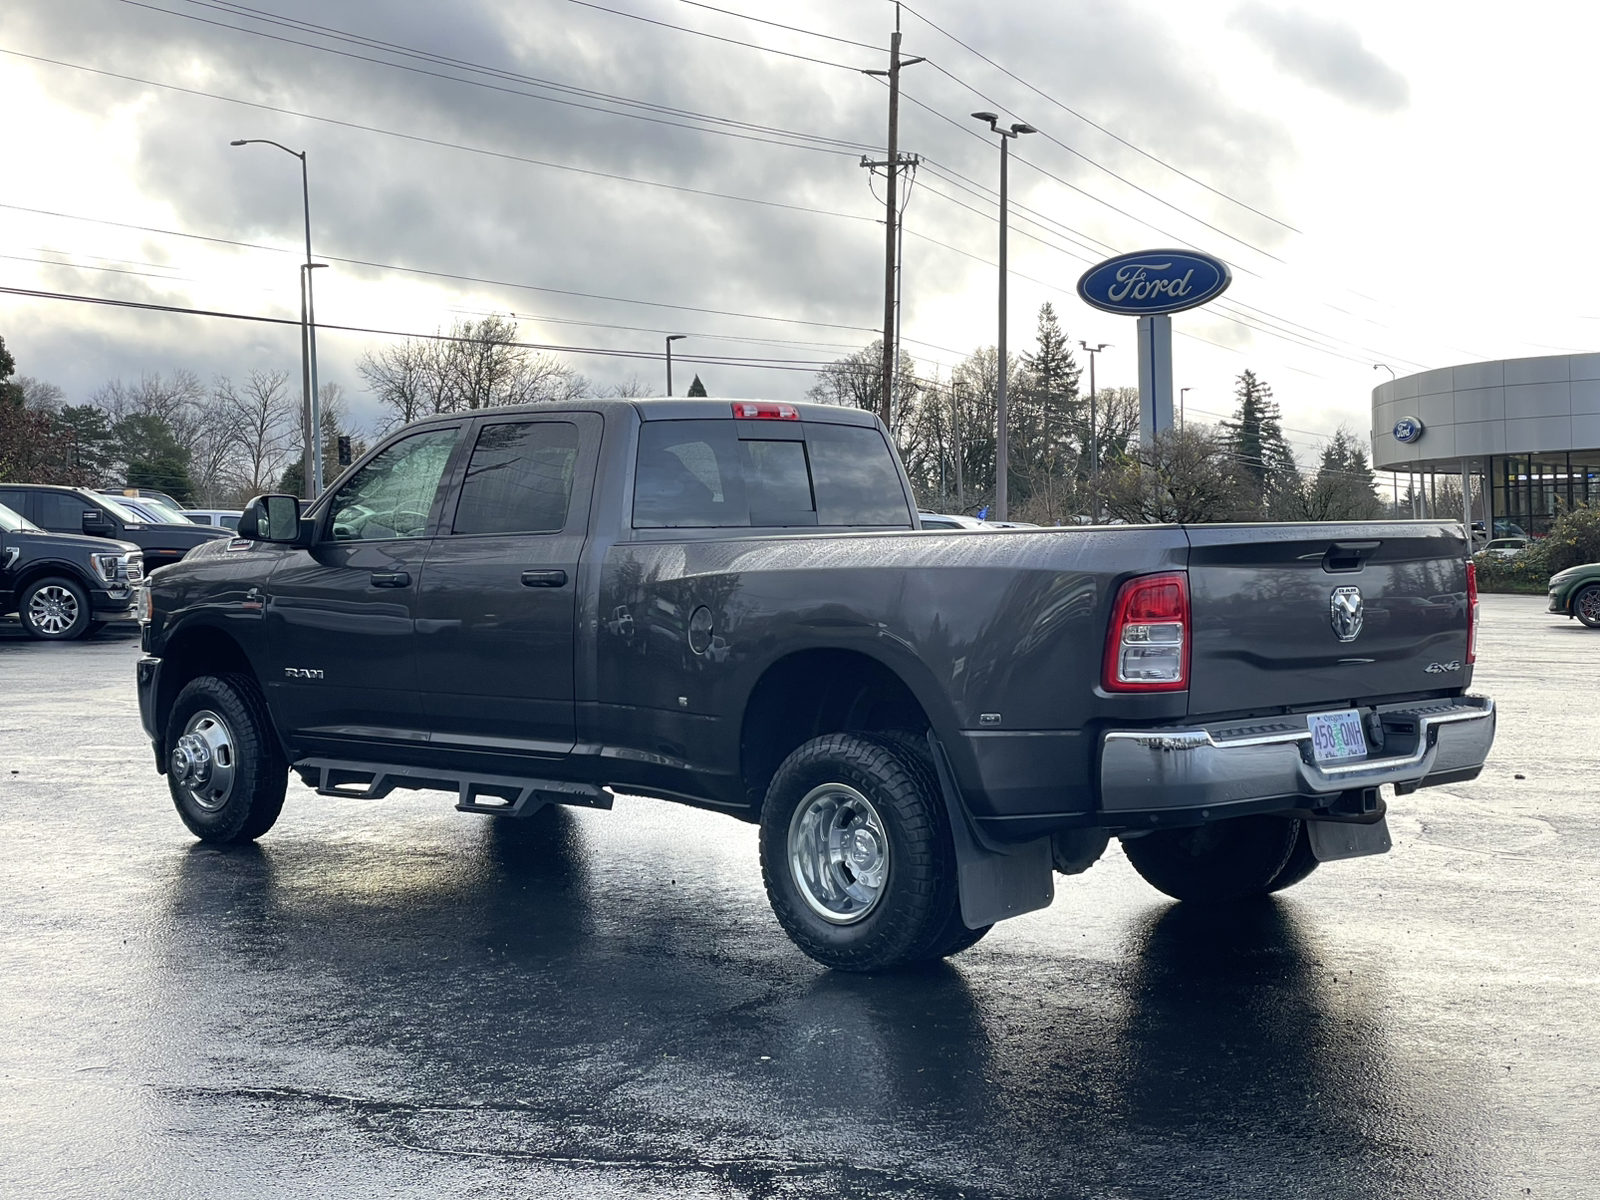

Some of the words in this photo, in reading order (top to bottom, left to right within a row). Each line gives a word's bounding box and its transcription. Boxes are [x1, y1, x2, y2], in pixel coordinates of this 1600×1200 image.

[1108, 262, 1194, 302] Ford
[1397, 422, 1411, 438] Ford
[285, 667, 324, 679] RAM
[1323, 713, 1344, 723] Oregon
[1314, 724, 1336, 750] 458
